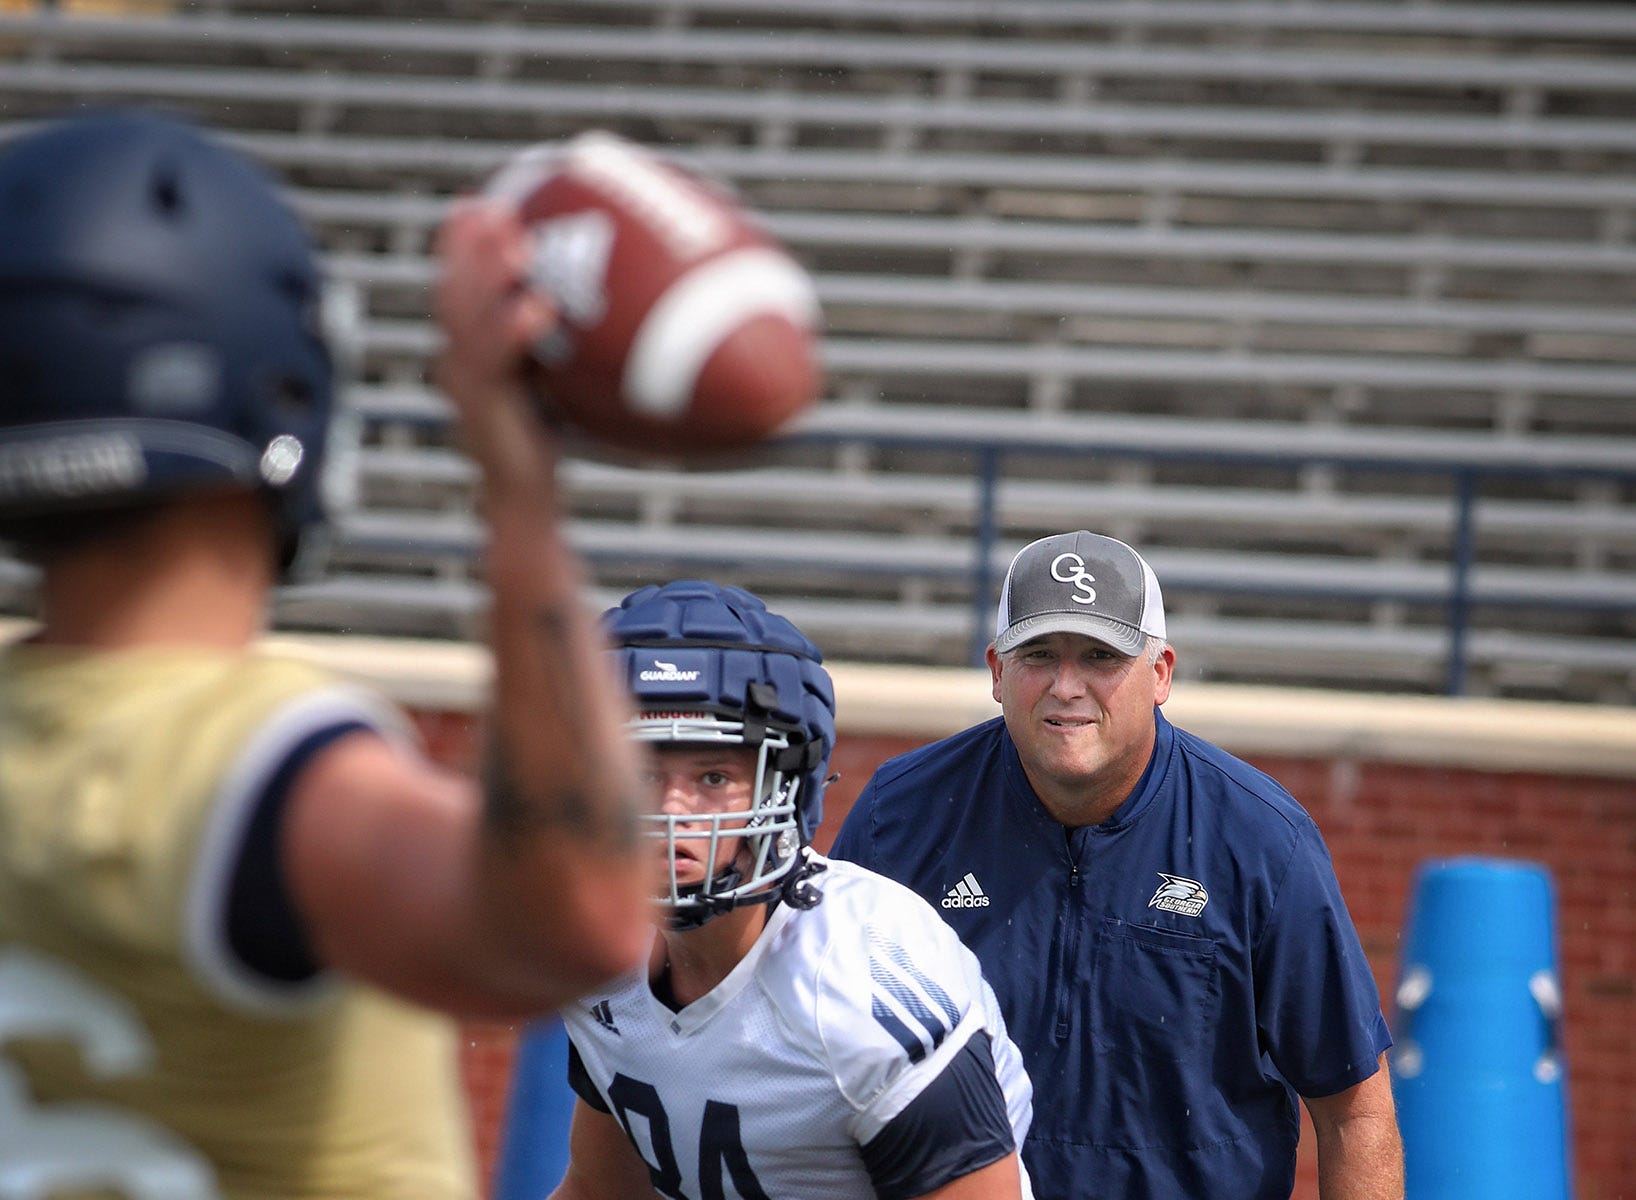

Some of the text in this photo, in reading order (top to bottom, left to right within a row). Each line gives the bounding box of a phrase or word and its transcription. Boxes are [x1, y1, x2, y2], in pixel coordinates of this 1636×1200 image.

[1050, 552, 1097, 604] GS
[640, 670, 698, 681] GUARDIAN
[941, 895, 990, 908] adidas
[1159, 901, 1199, 915] SOUTHERN
[1163, 896, 1202, 910] GEORGIA
